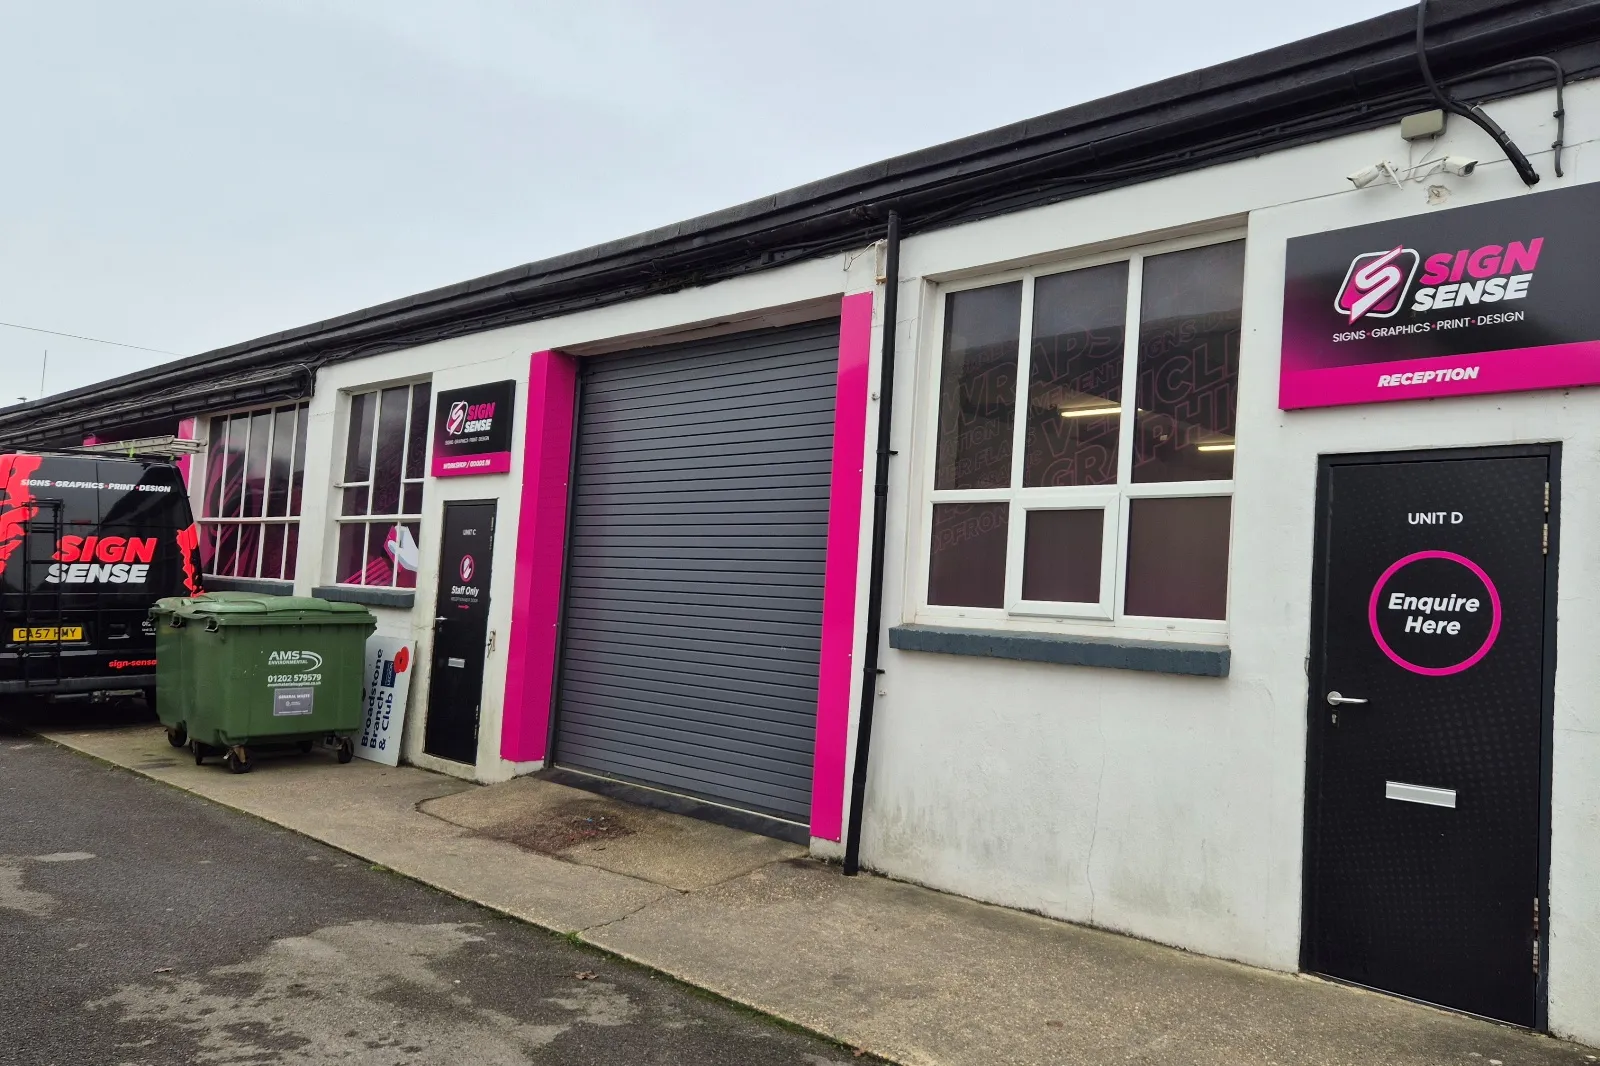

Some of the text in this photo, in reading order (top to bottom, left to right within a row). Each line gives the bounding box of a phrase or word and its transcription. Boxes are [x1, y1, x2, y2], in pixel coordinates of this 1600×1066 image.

[1419, 237, 1545, 286] SIGN
[1411, 272, 1533, 312] SENSE
[1332, 311, 1525, 343] SIGNS GRAPHICS PRINT DESIGN
[1377, 366, 1479, 388] RECEPTION
[467, 402, 495, 420] SIGN
[464, 418, 492, 433] SENSE
[20, 479, 171, 493] SIGNS GRAPHICS PRINT DESIGN
[1407, 512, 1464, 525] UNIT D
[52, 534, 158, 563] SIGN
[45, 563, 150, 584] SENSE
[451, 585, 480, 597] Staff Only
[1388, 592, 1480, 614] Enquire
[18, 628, 49, 640] CA57
[1405, 616, 1461, 635] Here
[269, 651, 300, 660] AMS
[293, 673, 322, 681] 579579
[361, 648, 384, 747] Broadstone
[369, 690, 385, 749] Branch
[379, 692, 394, 751] & Club
